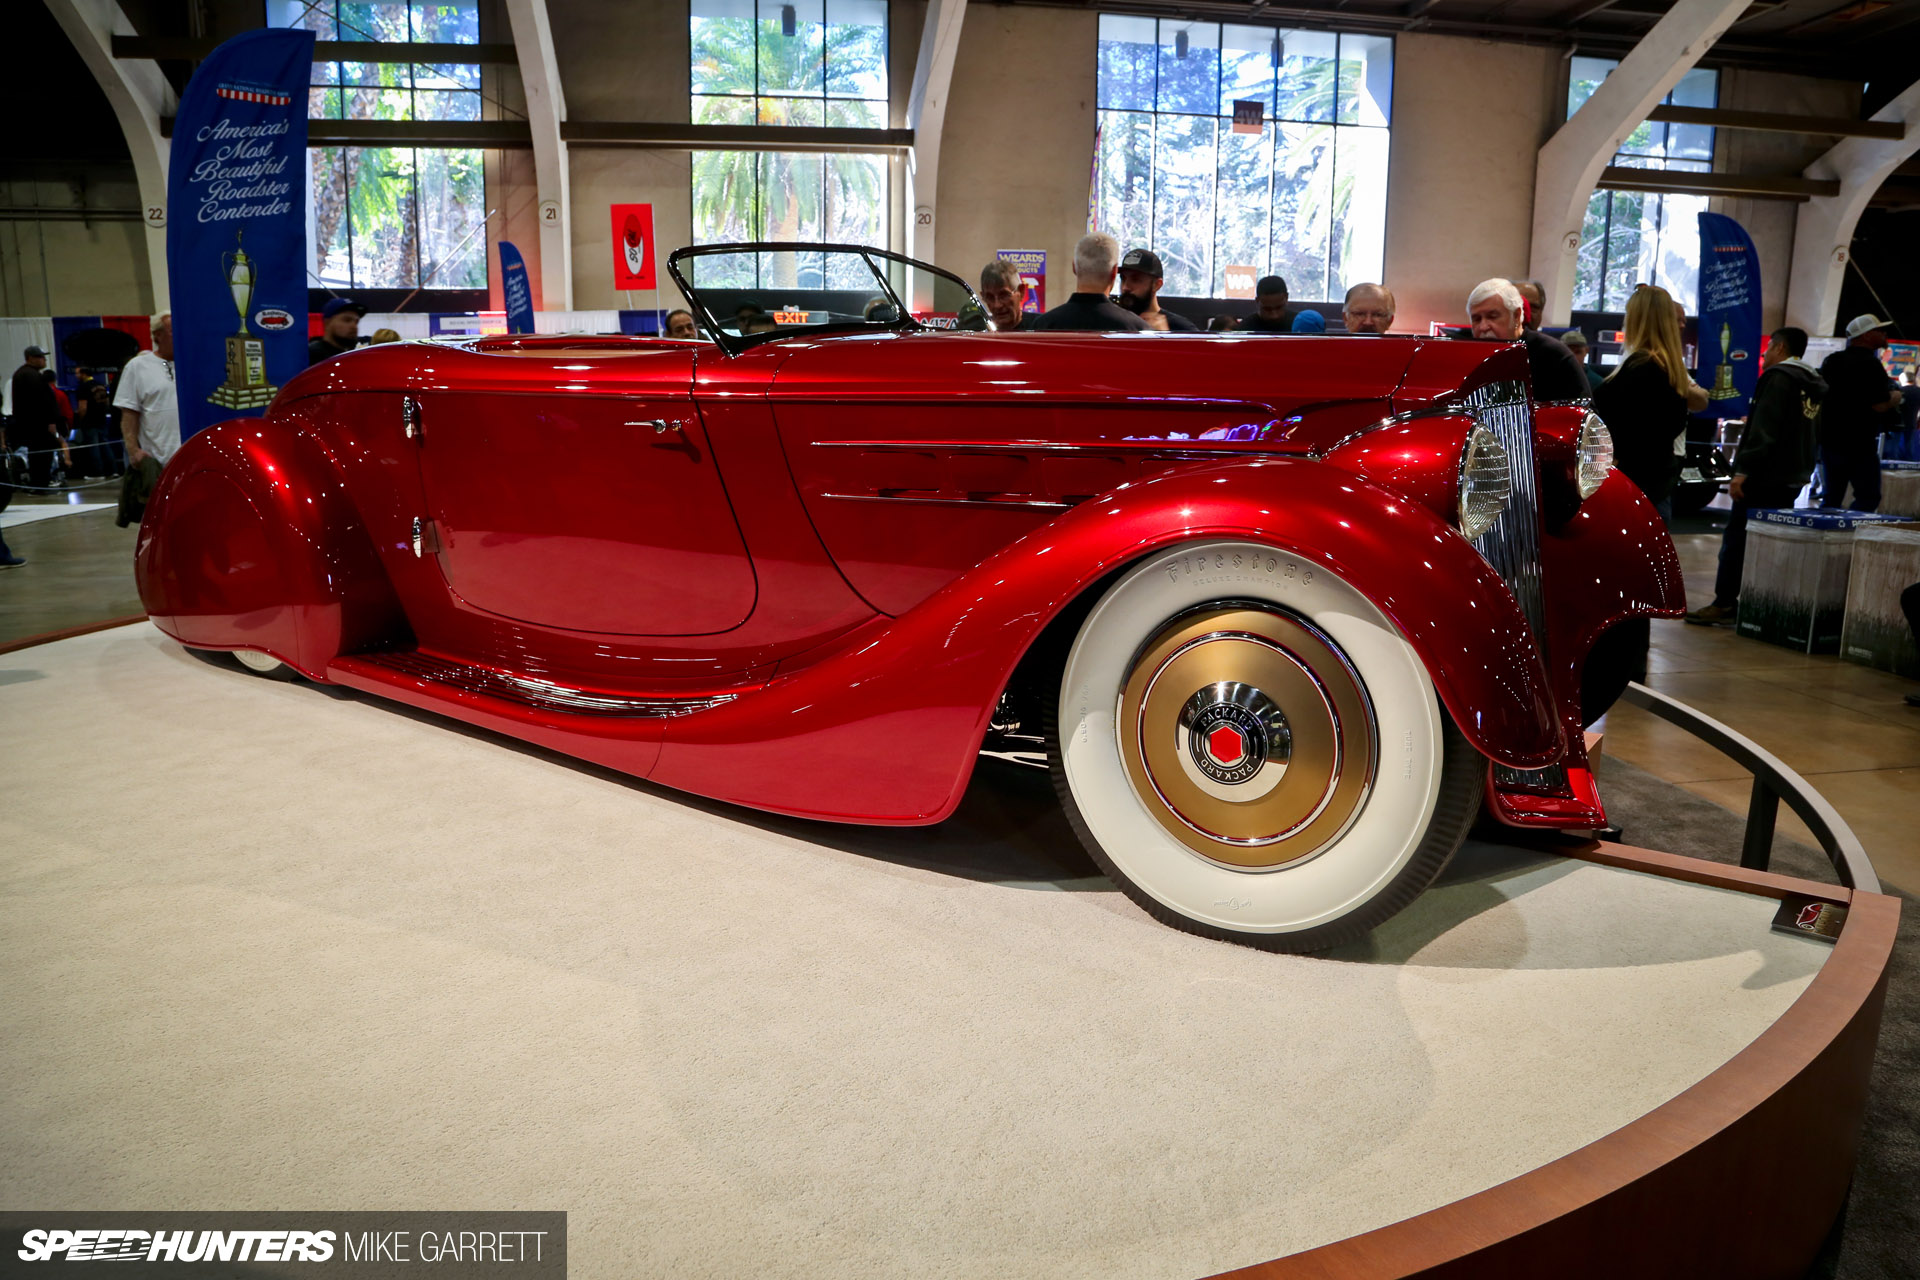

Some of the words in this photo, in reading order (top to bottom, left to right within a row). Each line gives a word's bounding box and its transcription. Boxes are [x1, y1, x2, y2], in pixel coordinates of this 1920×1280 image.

[197, 118, 289, 142] America's
[216, 138, 273, 161] Most
[189, 156, 288, 182] Beautiful
[200, 179, 290, 203] Roadster
[148, 207, 164, 220] 22
[197, 197, 291, 223] Contender
[545, 207, 556, 220] 21
[918, 213, 931, 225] 20
[999, 253, 1044, 262] WIZARDS
[774, 312, 810, 323] EXIT
[1767, 513, 1801, 525] RECYCLE
[1165, 553, 1313, 585] Firestone
[1200, 707, 1254, 731] PACKARD
[1200, 758, 1254, 780] PACKARD
